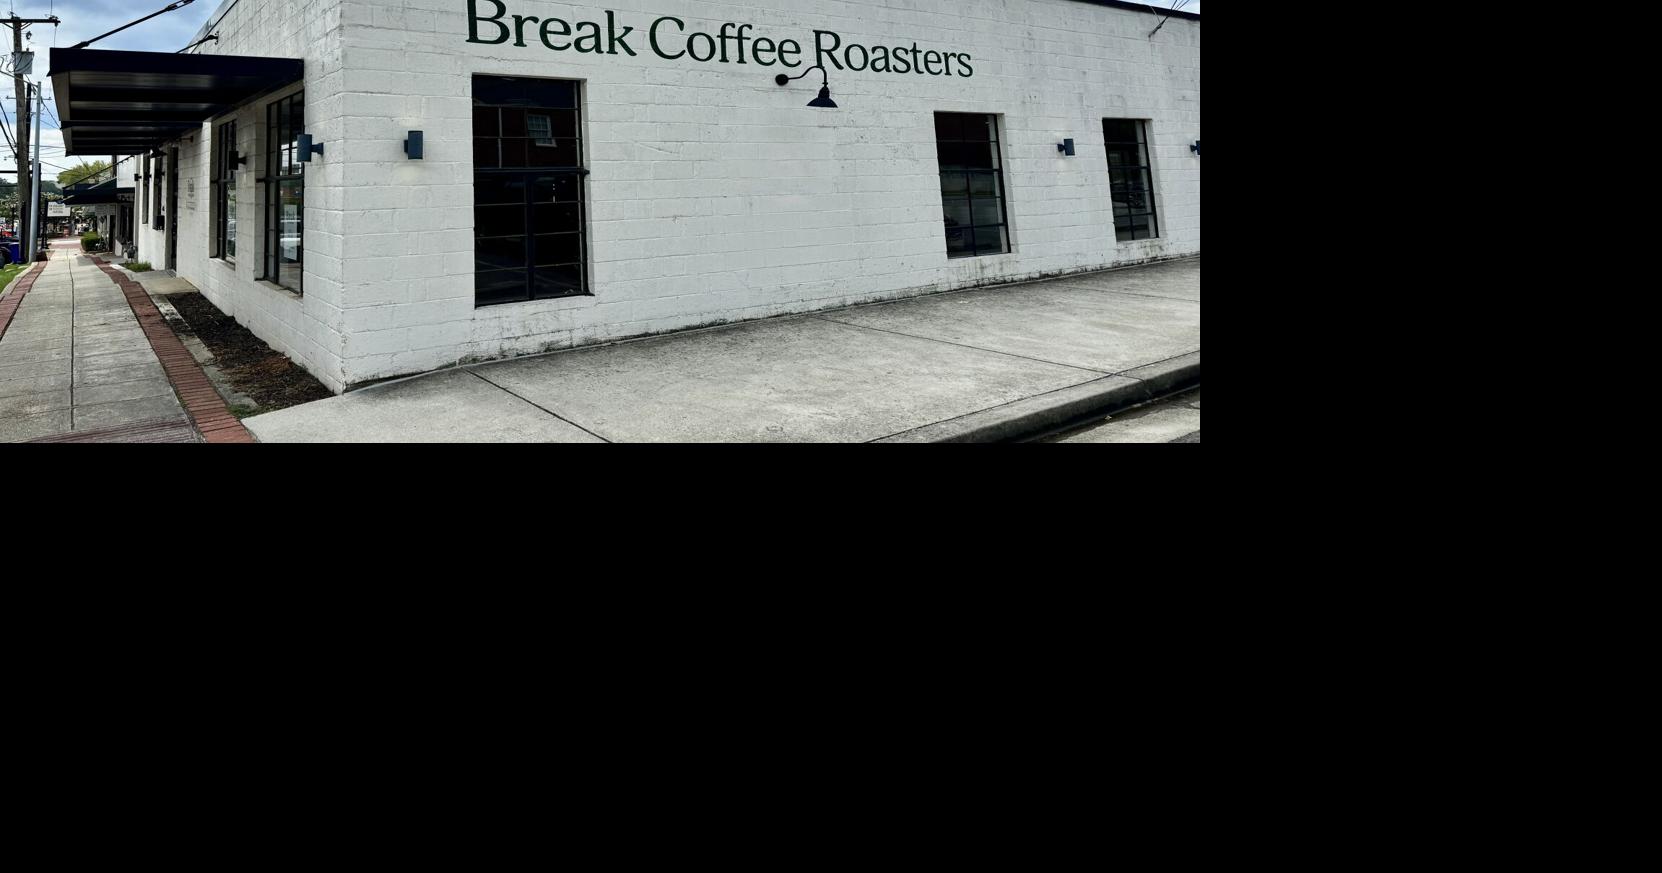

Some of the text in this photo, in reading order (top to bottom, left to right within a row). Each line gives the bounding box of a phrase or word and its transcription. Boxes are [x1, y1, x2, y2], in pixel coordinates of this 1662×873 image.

[465, 0, 974, 78] Break Coffee Roasters
